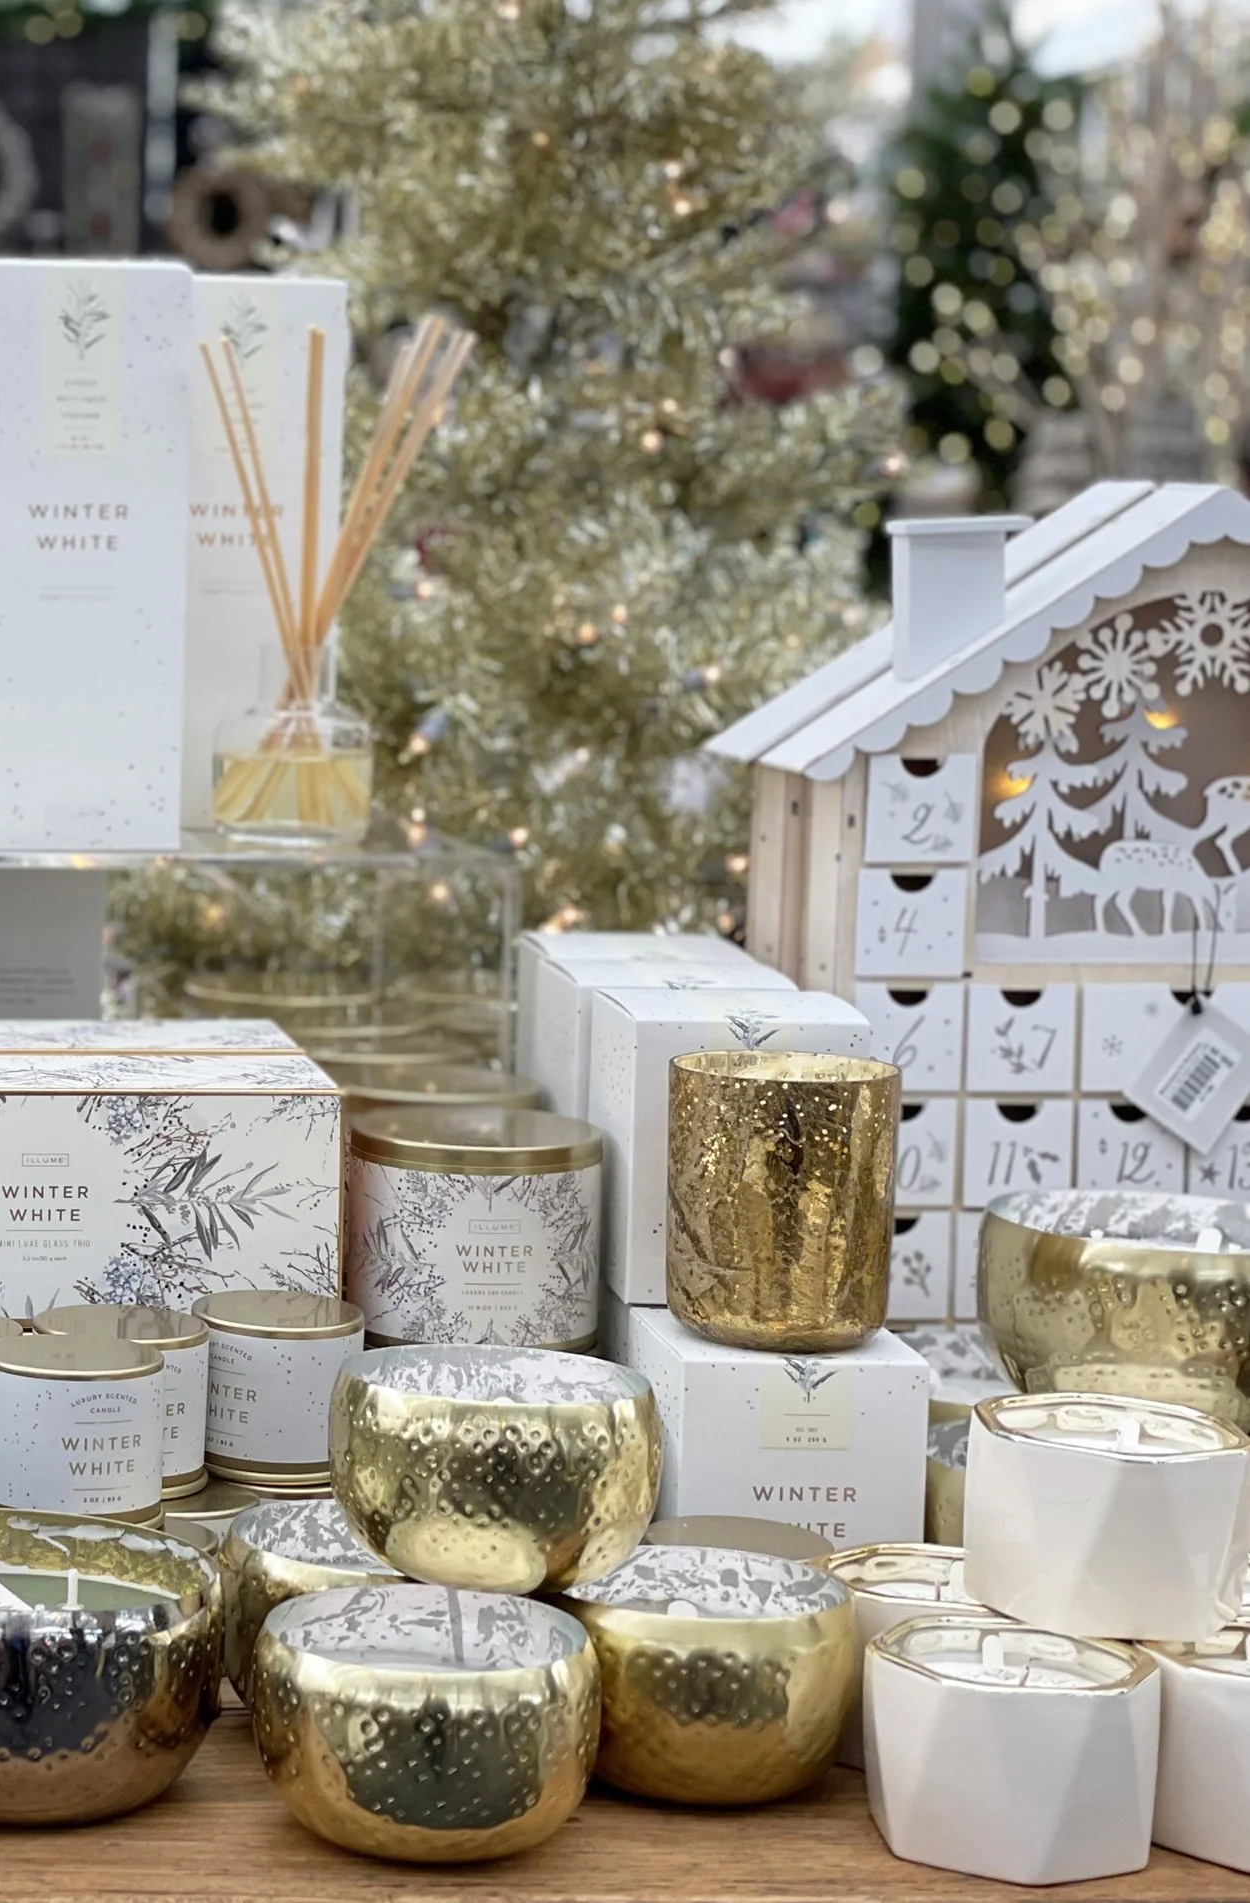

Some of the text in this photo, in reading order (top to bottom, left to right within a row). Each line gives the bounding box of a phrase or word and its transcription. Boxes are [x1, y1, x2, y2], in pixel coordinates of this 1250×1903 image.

[28, 503, 129, 520] WINTER
[36, 534, 118, 551] WHITE
[900, 801, 934, 846] 2
[893, 906, 919, 957] 4
[892, 1014, 926, 1070] 6
[1031, 1023, 1058, 1070] 7
[1115, 1142, 1156, 1184] 12
[1, 1186, 89, 1199] WINTER
[9, 1209, 81, 1222] WHITE
[18, 1239, 39, 1248] LUXE
[43, 1239, 69, 1248] GLASS
[455, 1244, 533, 1258] WINTER
[462, 1261, 526, 1274] WHITE
[221, 1343, 253, 1362] SCENTED
[210, 1381, 257, 1402] NTER
[71, 1393, 138, 1408] LUXURY SCENTED
[90, 1406, 121, 1414] CANDLE
[209, 1404, 249, 1424] HITE
[61, 1434, 141, 1452] WINTER
[69, 1459, 135, 1476] WHITE
[752, 1486, 857, 1502] WINTER
